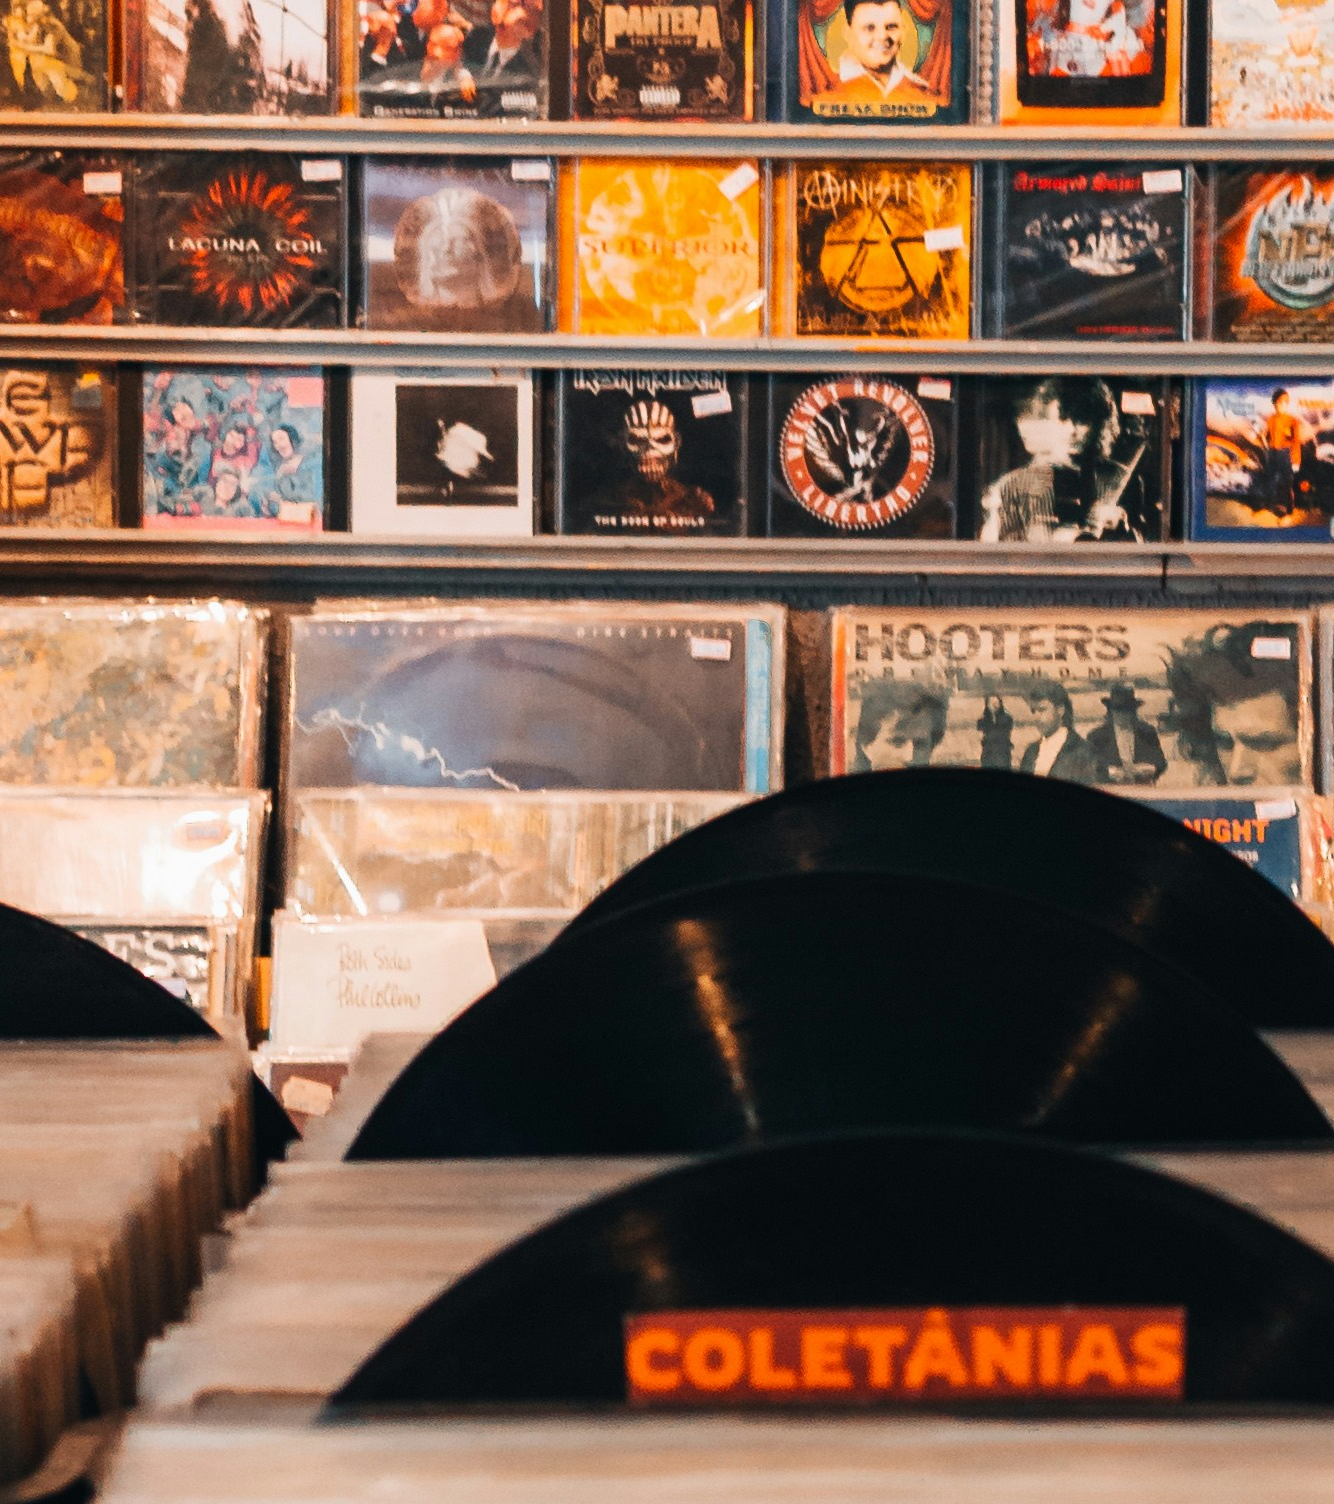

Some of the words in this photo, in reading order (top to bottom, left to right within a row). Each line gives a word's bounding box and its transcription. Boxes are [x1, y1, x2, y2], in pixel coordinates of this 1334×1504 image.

[604, 5, 724, 50] PANTERA
[804, 171, 958, 218] MINISTRY
[168, 239, 260, 254] LACUNA
[275, 239, 327, 254] COIL
[584, 237, 756, 257] SUPERIOR
[853, 377, 926, 465] REVOLVER
[853, 623, 1131, 662] HOOTERS
[627, 1308, 1184, 1391] COLETÂNIAS
